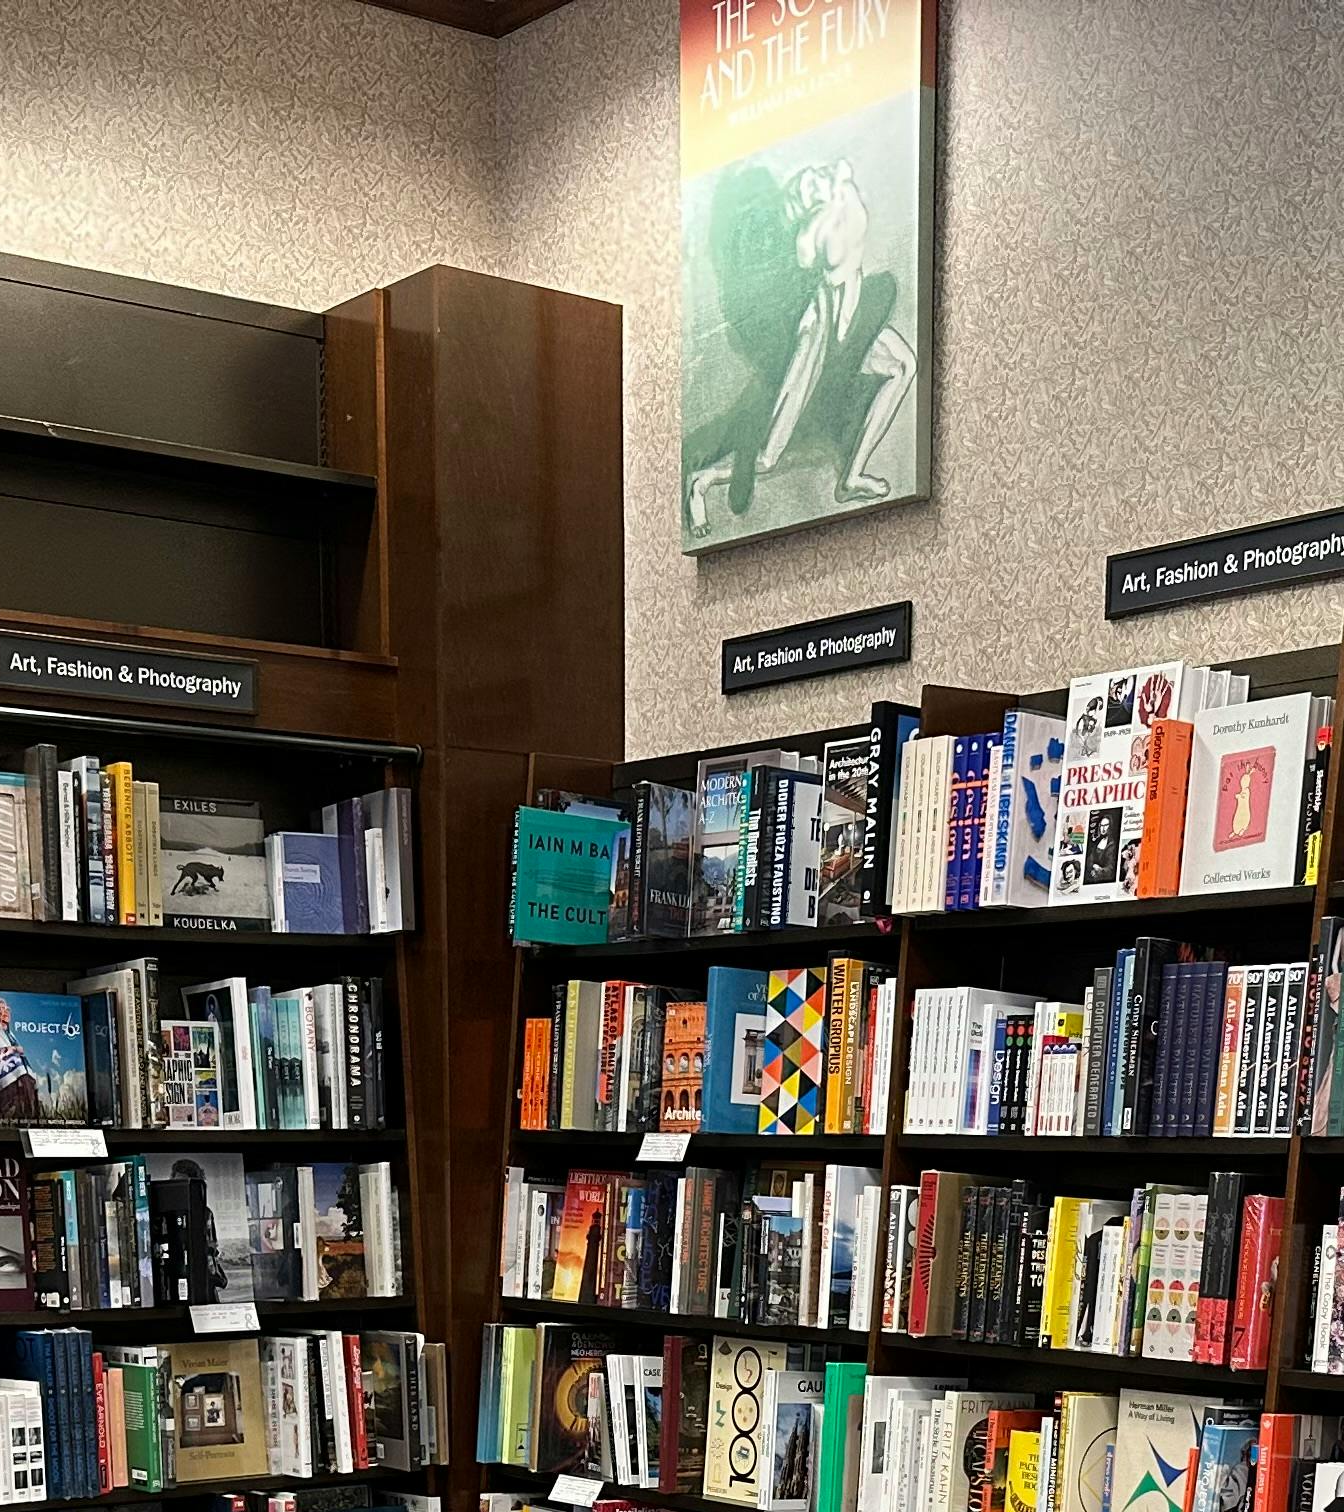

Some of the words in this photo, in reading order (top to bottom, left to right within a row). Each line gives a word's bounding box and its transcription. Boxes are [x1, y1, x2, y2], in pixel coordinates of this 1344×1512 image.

[713, 0, 755, 53] THE
[700, 49, 755, 111] AND
[762, 21, 809, 85] THE
[821, 0, 889, 63] FURY
[1122, 569, 1151, 594] Art,
[1155, 558, 1218, 589] Fashion
[1223, 554, 1238, 573] &
[733, 652, 755, 674] Art,
[757, 643, 802, 670] Fashion
[806, 641, 817, 659] &
[820, 626, 896, 659] Photography
[10, 653, 42, 676] Art,
[47, 657, 113, 682] Fashion
[118, 664, 133, 683] &
[138, 669, 242, 697] Photography
[1003, 713, 1018, 772] DANIEL
[1213, 719, 1251, 736] Dorothy
[1253, 713, 1289, 732] Kunhardt
[870, 727, 882, 790] GRAY
[1066, 760, 1123, 787] PRESS
[173, 799, 218, 814] EXILES
[996, 774, 1016, 871] LIBESKIND
[864, 798, 877, 869] MALIN
[172, 916, 238, 931] KOUDELKA
[831, 964, 845, 1012] WALTER
[14, 1019, 60, 1036] PROJECT
[347, 982, 362, 1089] CHRONORAMA
[828, 1014, 842, 1075] GROPIUS
[943, 1421, 954, 1464] FRITZ
[937, 1467, 948, 1505] KAHN
